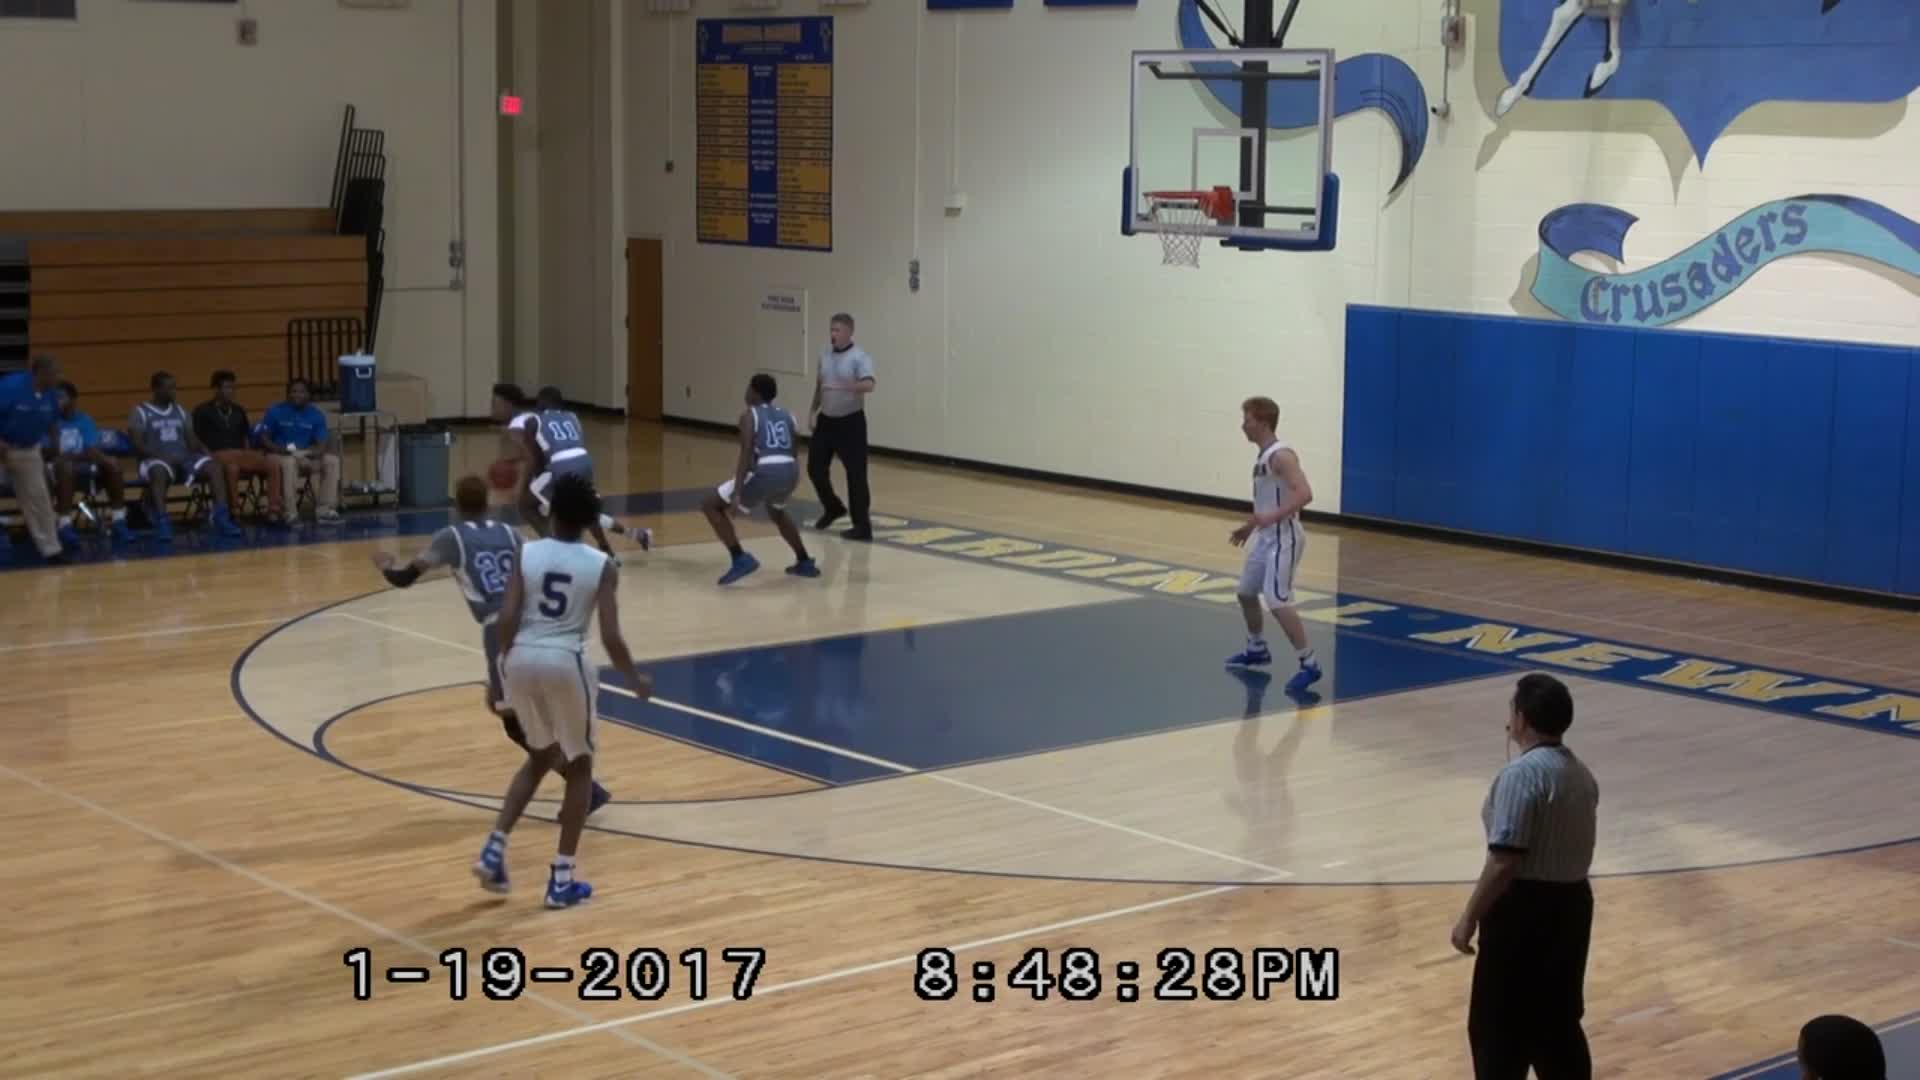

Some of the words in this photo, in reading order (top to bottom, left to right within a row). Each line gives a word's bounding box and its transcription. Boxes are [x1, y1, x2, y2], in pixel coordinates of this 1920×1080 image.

[1580, 203, 1809, 323] Crusaders
[548, 421, 580, 440] 11
[538, 571, 573, 618] 5
